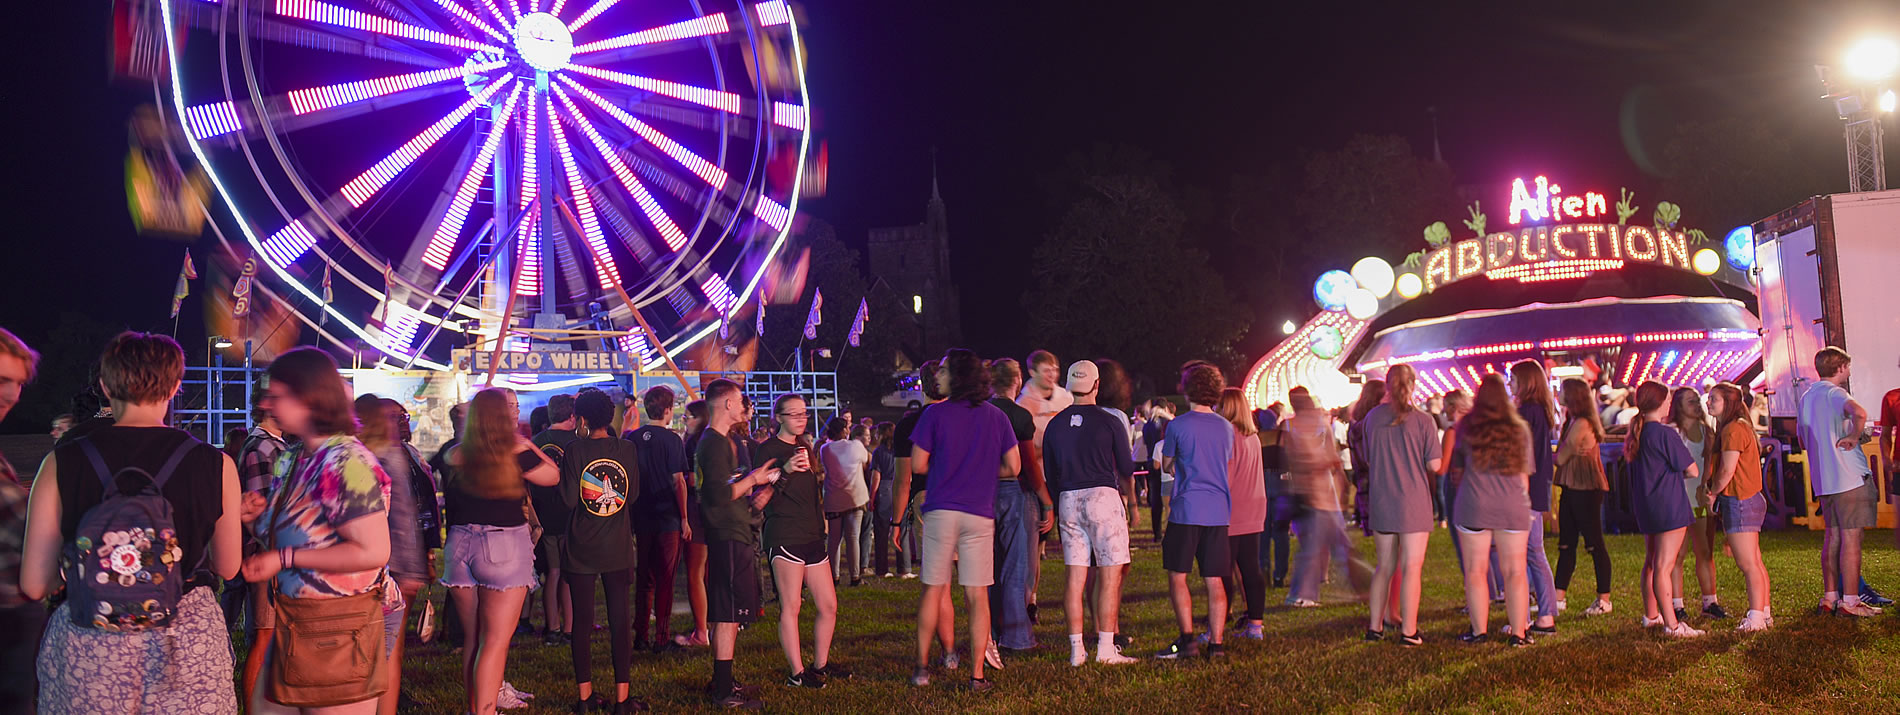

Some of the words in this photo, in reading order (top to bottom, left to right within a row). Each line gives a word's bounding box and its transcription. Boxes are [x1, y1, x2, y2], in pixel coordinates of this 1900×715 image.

[1509, 175, 1607, 225] Alien
[1424, 223, 1692, 293] ABDUCTION
[475, 352, 543, 369] EXPO
[550, 352, 624, 369] WHEEL
